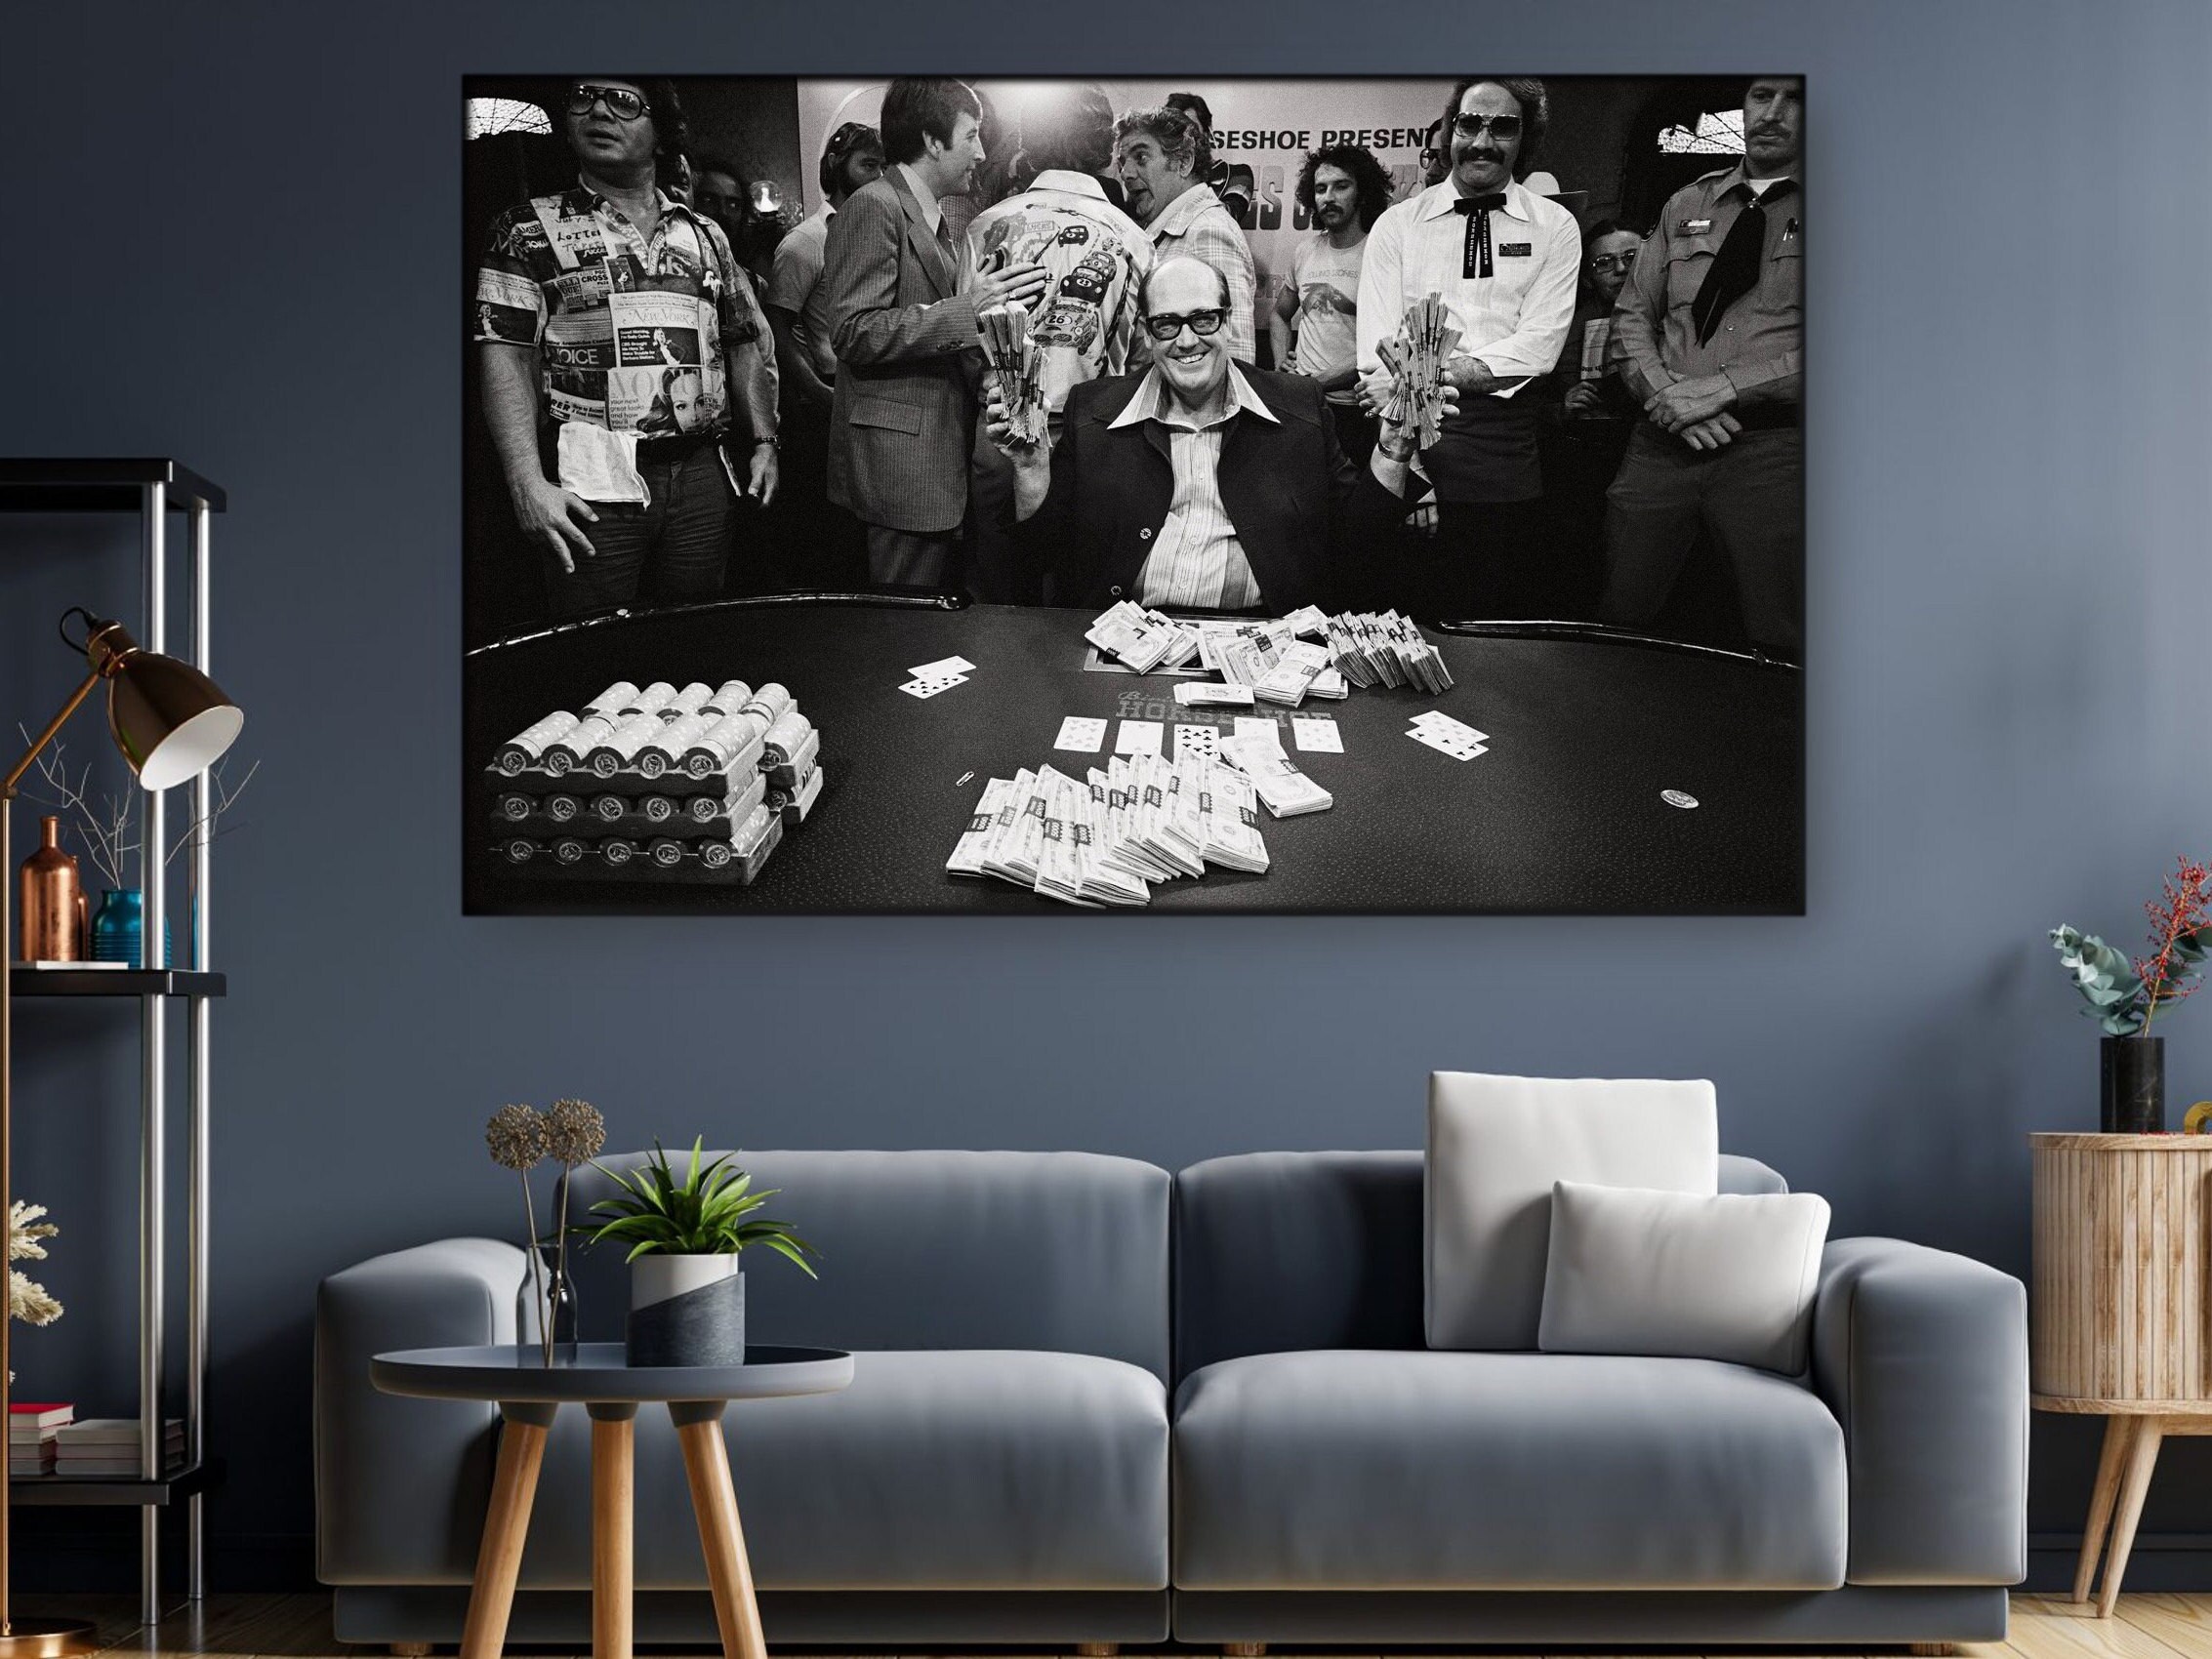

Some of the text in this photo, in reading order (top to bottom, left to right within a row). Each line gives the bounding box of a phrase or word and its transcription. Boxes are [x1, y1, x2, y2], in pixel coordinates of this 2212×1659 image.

[1322, 128, 1430, 148] PRESEN
[1048, 314, 1065, 324] 26
[557, 348, 600, 365] OICE
